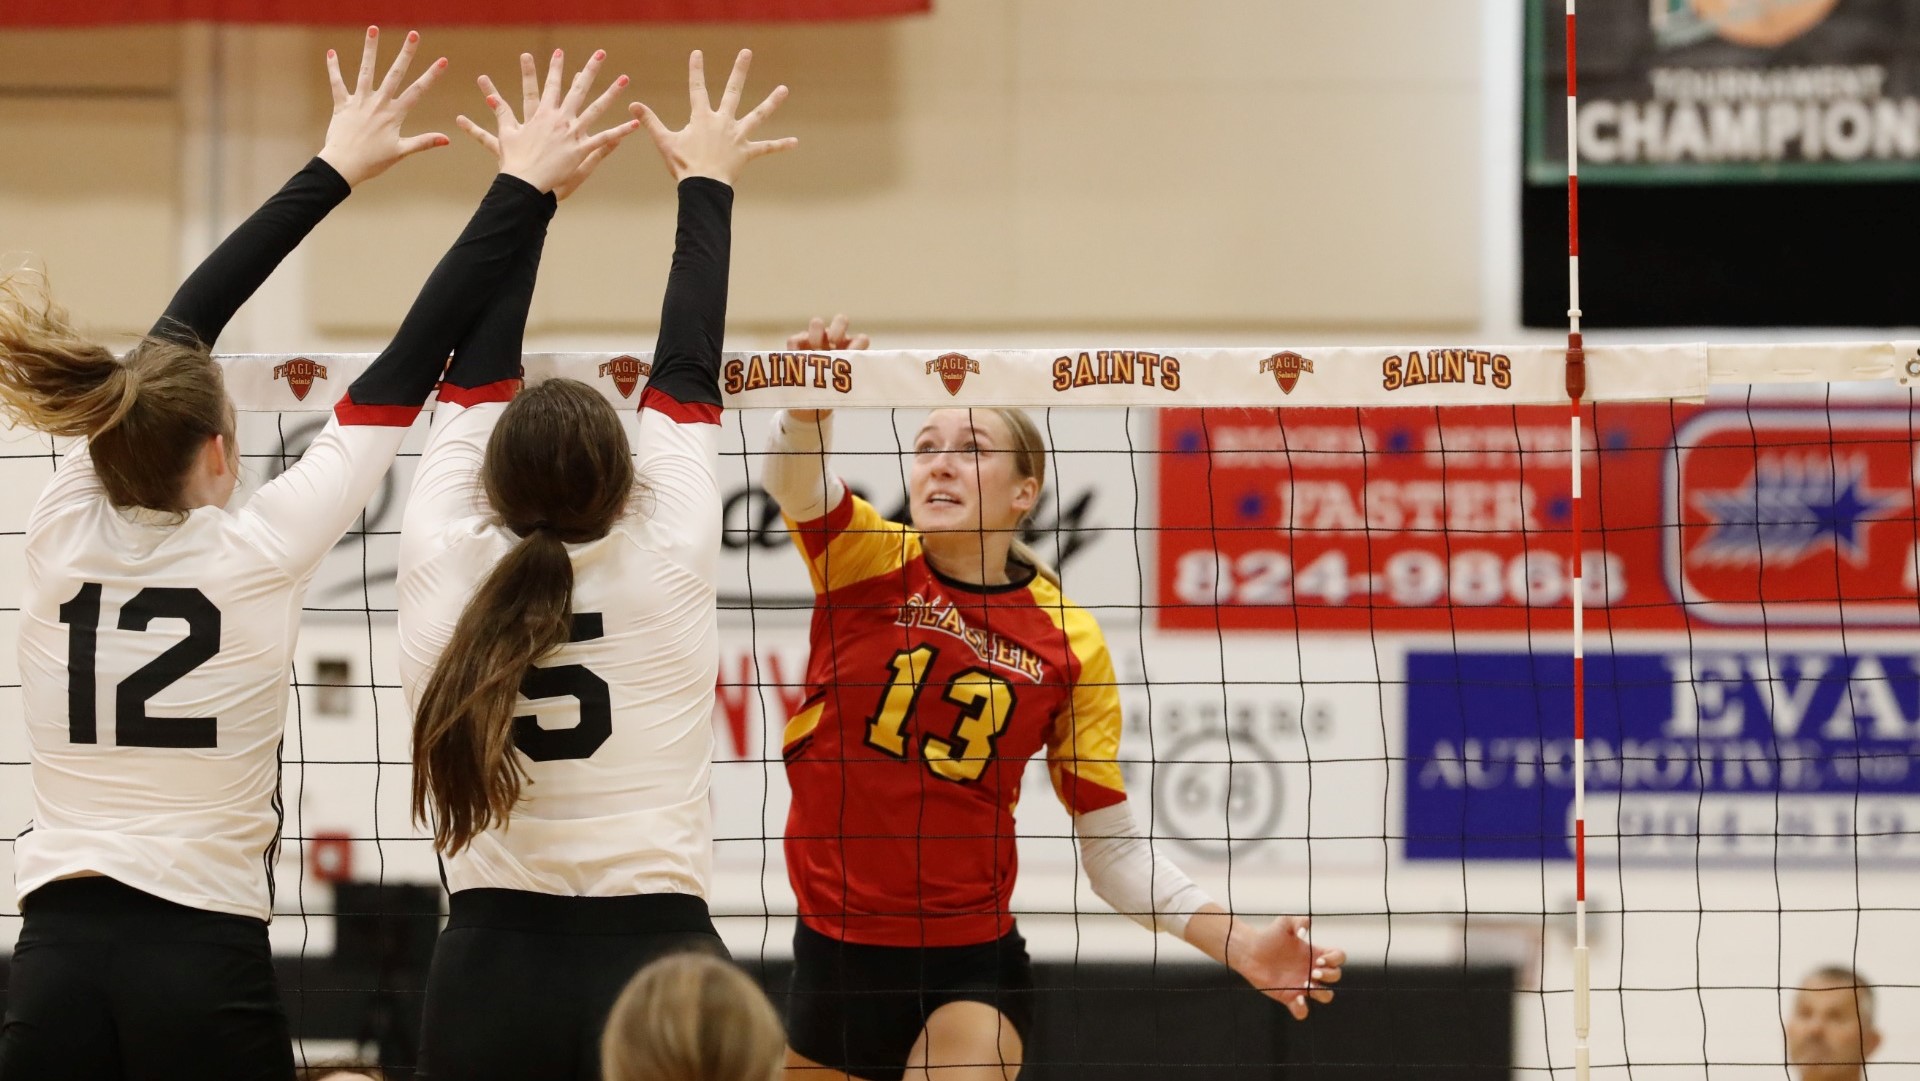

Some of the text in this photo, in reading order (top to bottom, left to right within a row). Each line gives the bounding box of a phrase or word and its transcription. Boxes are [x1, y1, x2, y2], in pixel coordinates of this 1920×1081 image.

[273, 362, 328, 380] FLAGLER
[290, 377, 311, 385] Saints
[615, 374, 635, 383] Saints
[725, 353, 852, 395] SAINTS
[925, 357, 981, 375] FLAGLER
[1053, 350, 1180, 391] SAINTS
[1259, 355, 1314, 374] FLAGLER
[1383, 349, 1512, 391] SAINTS
[1277, 480, 1542, 538] FASTER
[58, 581, 222, 749] 12
[512, 612, 613, 762] 5
[1662, 655, 1920, 740] EVA
[863, 641, 1018, 784] 13
